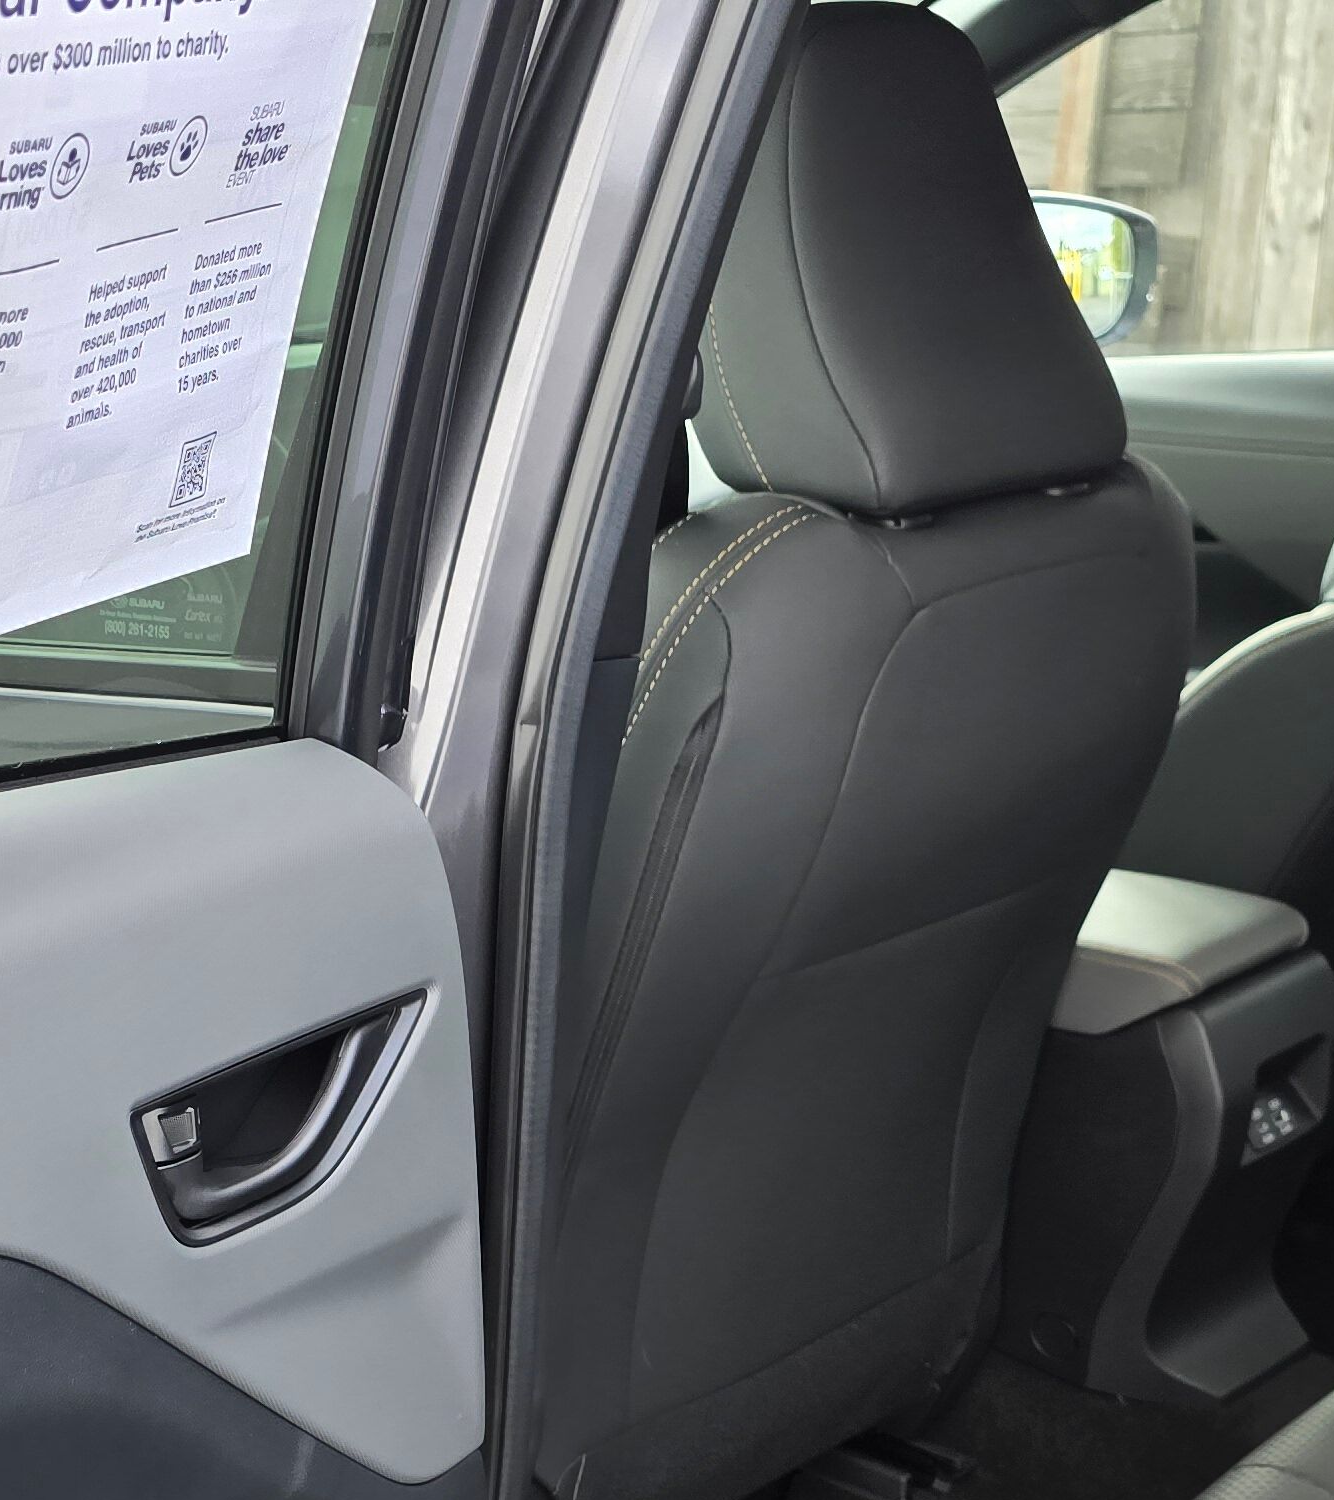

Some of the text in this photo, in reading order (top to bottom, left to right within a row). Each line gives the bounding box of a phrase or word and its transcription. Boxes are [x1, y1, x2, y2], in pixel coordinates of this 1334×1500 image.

[7, 50, 49, 74] over
[52, 42, 92, 73] $300
[97, 37, 151, 66] million
[157, 36, 171, 59] to
[176, 30, 229, 60] charity.
[250, 101, 285, 121] SUBARU
[140, 119, 177, 136] SUBARU
[242, 121, 285, 147] share
[9, 137, 52, 155] SUBARU
[126, 139, 170, 161] Loves
[129, 162, 162, 183] Pets
[226, 170, 256, 188] EVENT
[194, 241, 263, 271] Donated more
[88, 264, 168, 304] Helped support
[189, 262, 272, 295] than $256 million
[84, 295, 150, 329] the adoption,
[184, 285, 258, 320] to national and
[79, 312, 166, 354] rescue, transport
[181, 317, 231, 345] hometown
[74, 341, 143, 380] and health of
[178, 336, 243, 369] charities over
[70, 367, 137, 404] over 420,000
[177, 368, 219, 393] 15 years.
[66, 401, 113, 430] animals.
